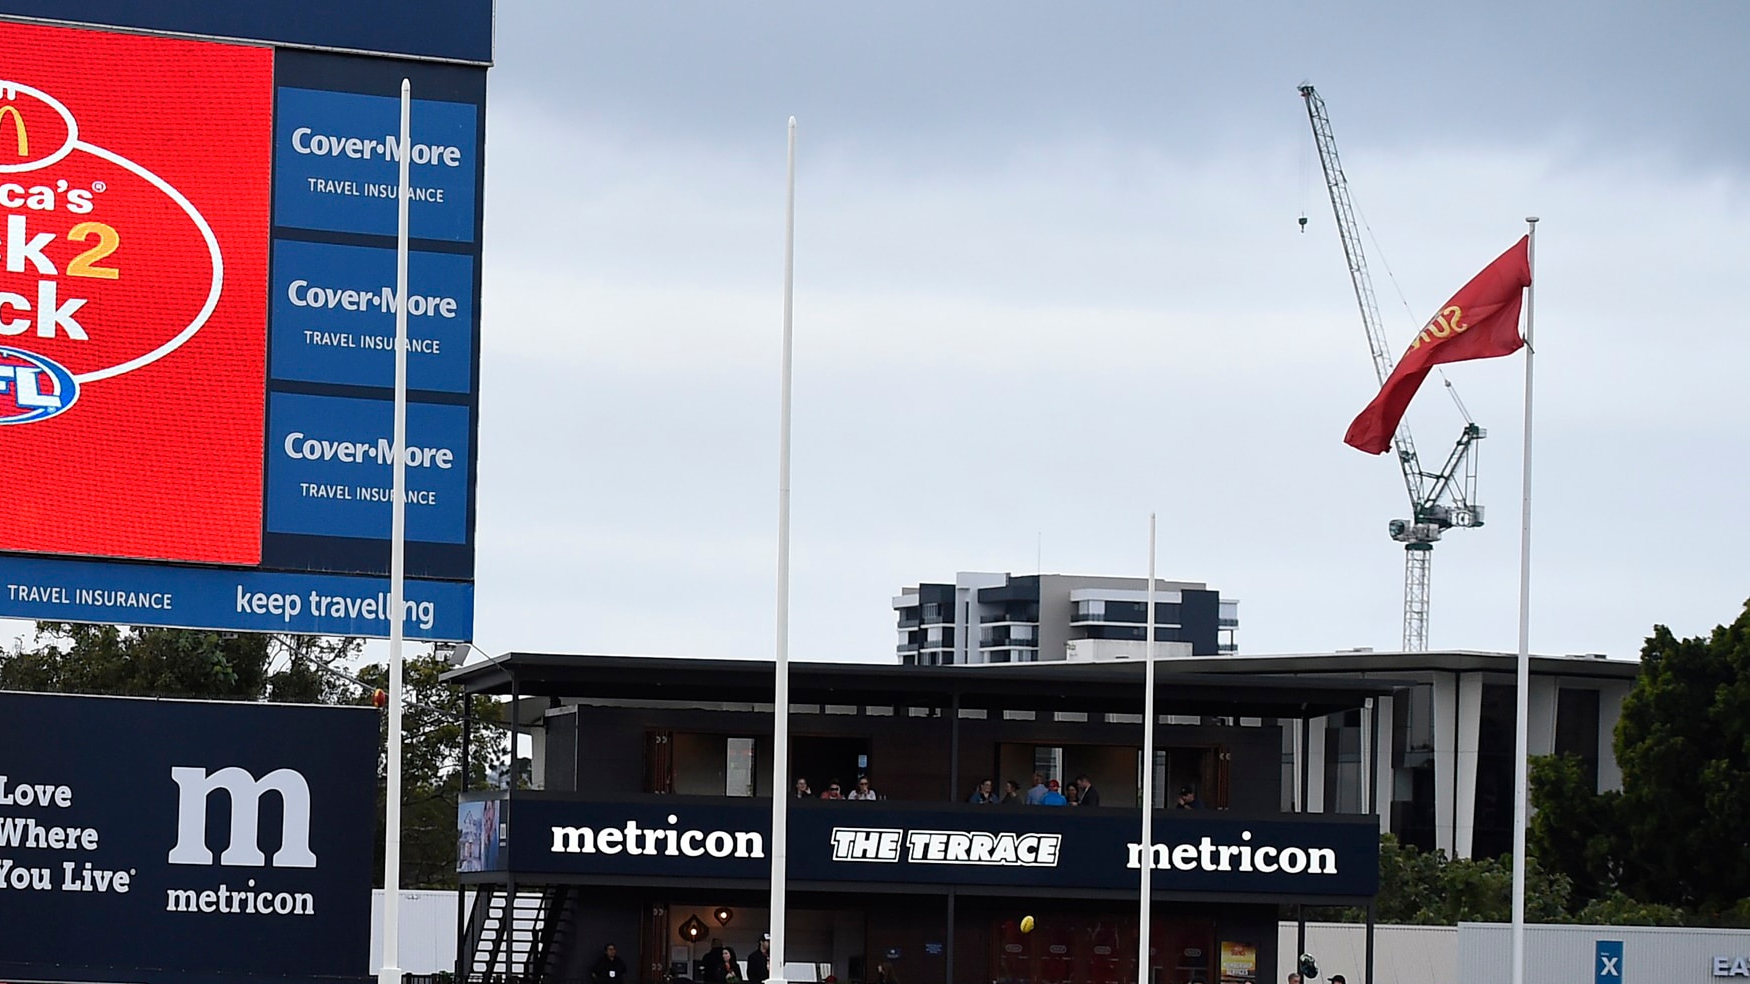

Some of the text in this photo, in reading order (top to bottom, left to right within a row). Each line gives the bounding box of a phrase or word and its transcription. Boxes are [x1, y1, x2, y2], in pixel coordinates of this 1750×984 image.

[307, 178, 444, 203] TRAVEL INSUANCE
[303, 330, 440, 354] TRAVEL INSUANCE
[300, 483, 352, 500] TRAVEL
[7, 584, 70, 604] TRAVEL
[75, 589, 172, 610] INSURANCE
[236, 584, 434, 630] keep travellng
[168, 766, 317, 868] m
[550, 814, 765, 858] metricon
[831, 827, 1062, 867] THE TERRACE
[1126, 830, 1338, 875] metricon
[166, 878, 315, 915] metricon
[1600, 956, 1619, 977] X
[1713, 956, 1750, 977] EA
